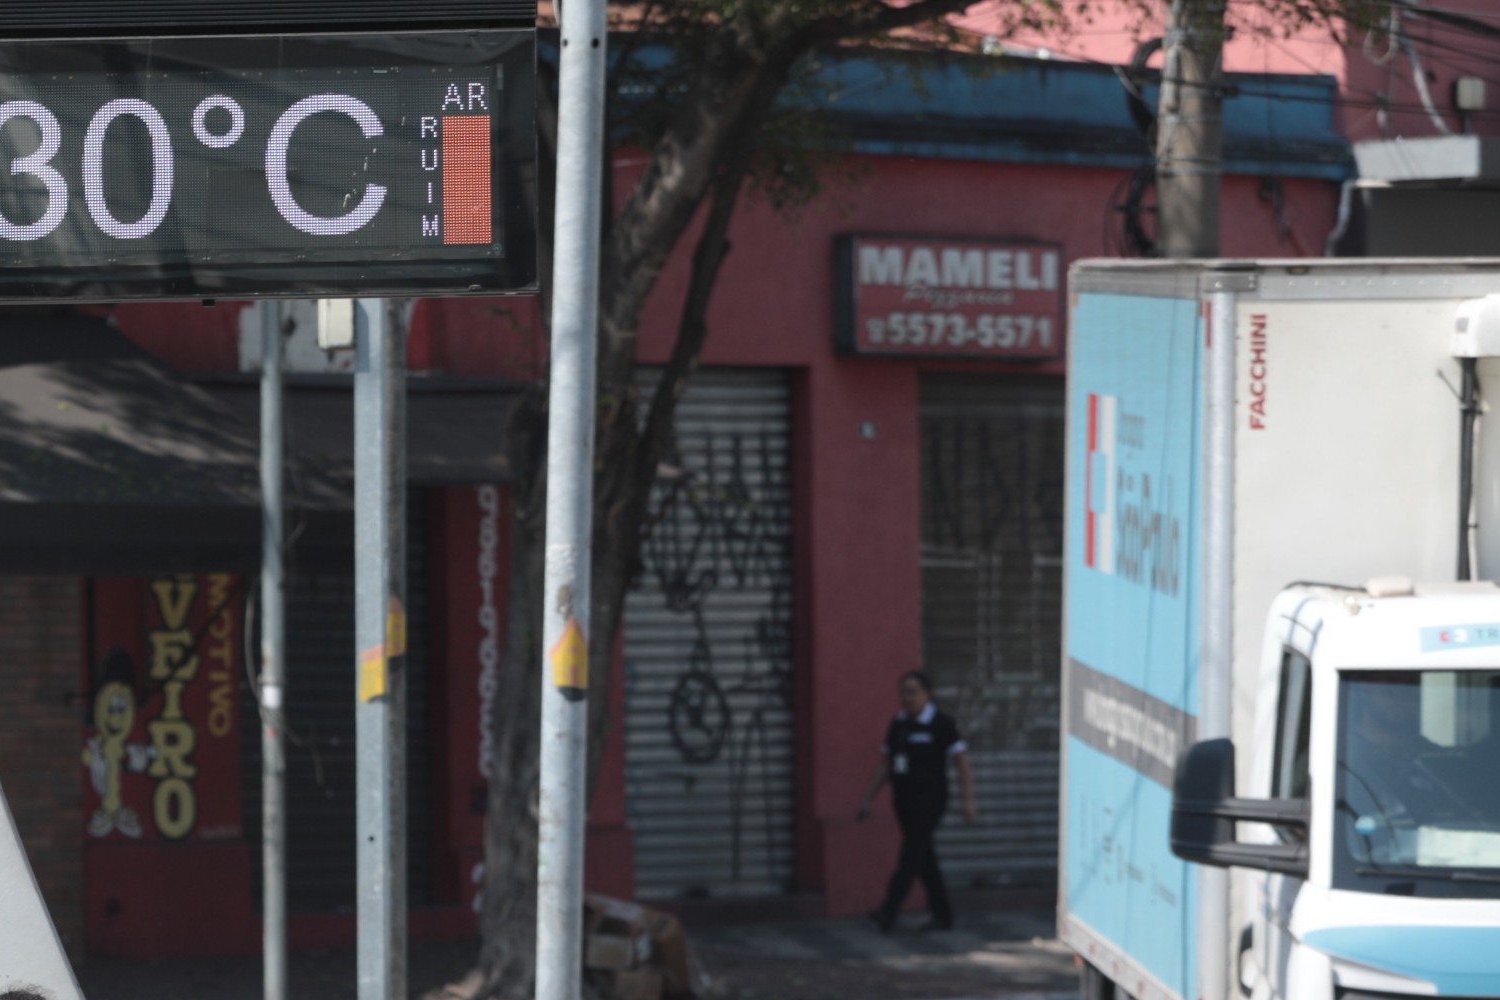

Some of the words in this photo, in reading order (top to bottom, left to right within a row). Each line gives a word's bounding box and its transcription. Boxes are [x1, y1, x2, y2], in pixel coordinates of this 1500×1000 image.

[442, 83, 488, 110] AR
[421, 116, 439, 238] RUIM
[859, 246, 1058, 290] MAMELI
[888, 312, 1051, 347] 5573-5571
[1250, 313, 1267, 430] FACCHINI
[148, 574, 197, 838] VEIRO
